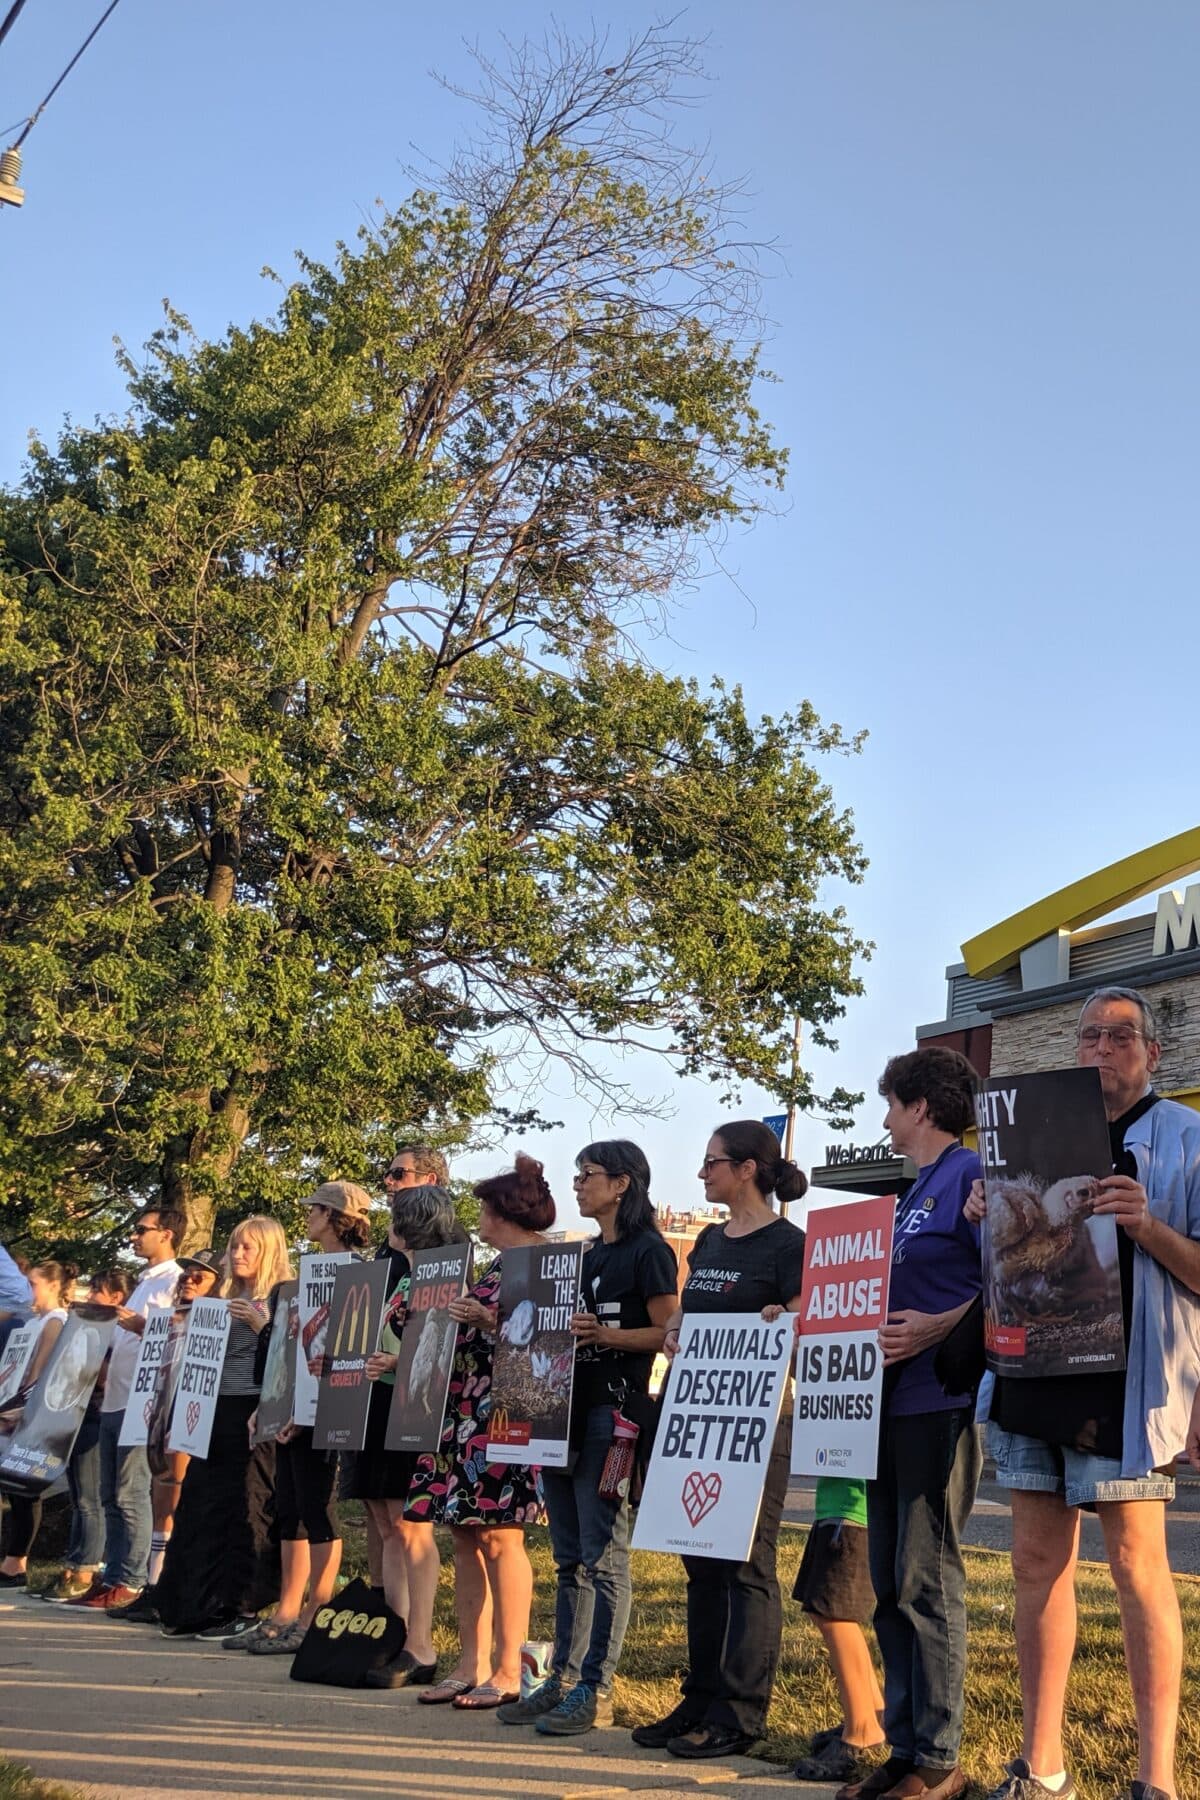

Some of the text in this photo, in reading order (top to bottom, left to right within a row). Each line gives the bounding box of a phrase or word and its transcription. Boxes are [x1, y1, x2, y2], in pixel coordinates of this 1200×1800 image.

[809, 1229, 885, 1269] ANIMAL
[311, 1263, 323, 1278] THE
[416, 1259, 461, 1280] STOP THIS
[541, 1253, 577, 1279] LEARN
[696, 1269, 741, 1282] HUMANE
[306, 1282, 334, 1307] TRUT
[555, 1280, 575, 1304] THE
[805, 1277, 882, 1321] ABUSE
[192, 1307, 228, 1331] ANIMALS
[186, 1334, 223, 1361] DESERVE
[683, 1328, 786, 1361] ANIMALS
[331, 1358, 365, 1371] McDonald's
[801, 1342, 876, 1384] IS BAD
[135, 1367, 160, 1393] BET
[181, 1362, 218, 1398] BETTER
[330, 1372, 362, 1388] CRUELTY
[674, 1369, 776, 1408] DESERVE
[799, 1394, 873, 1421] BUSINESS
[662, 1413, 766, 1464] BETTER
